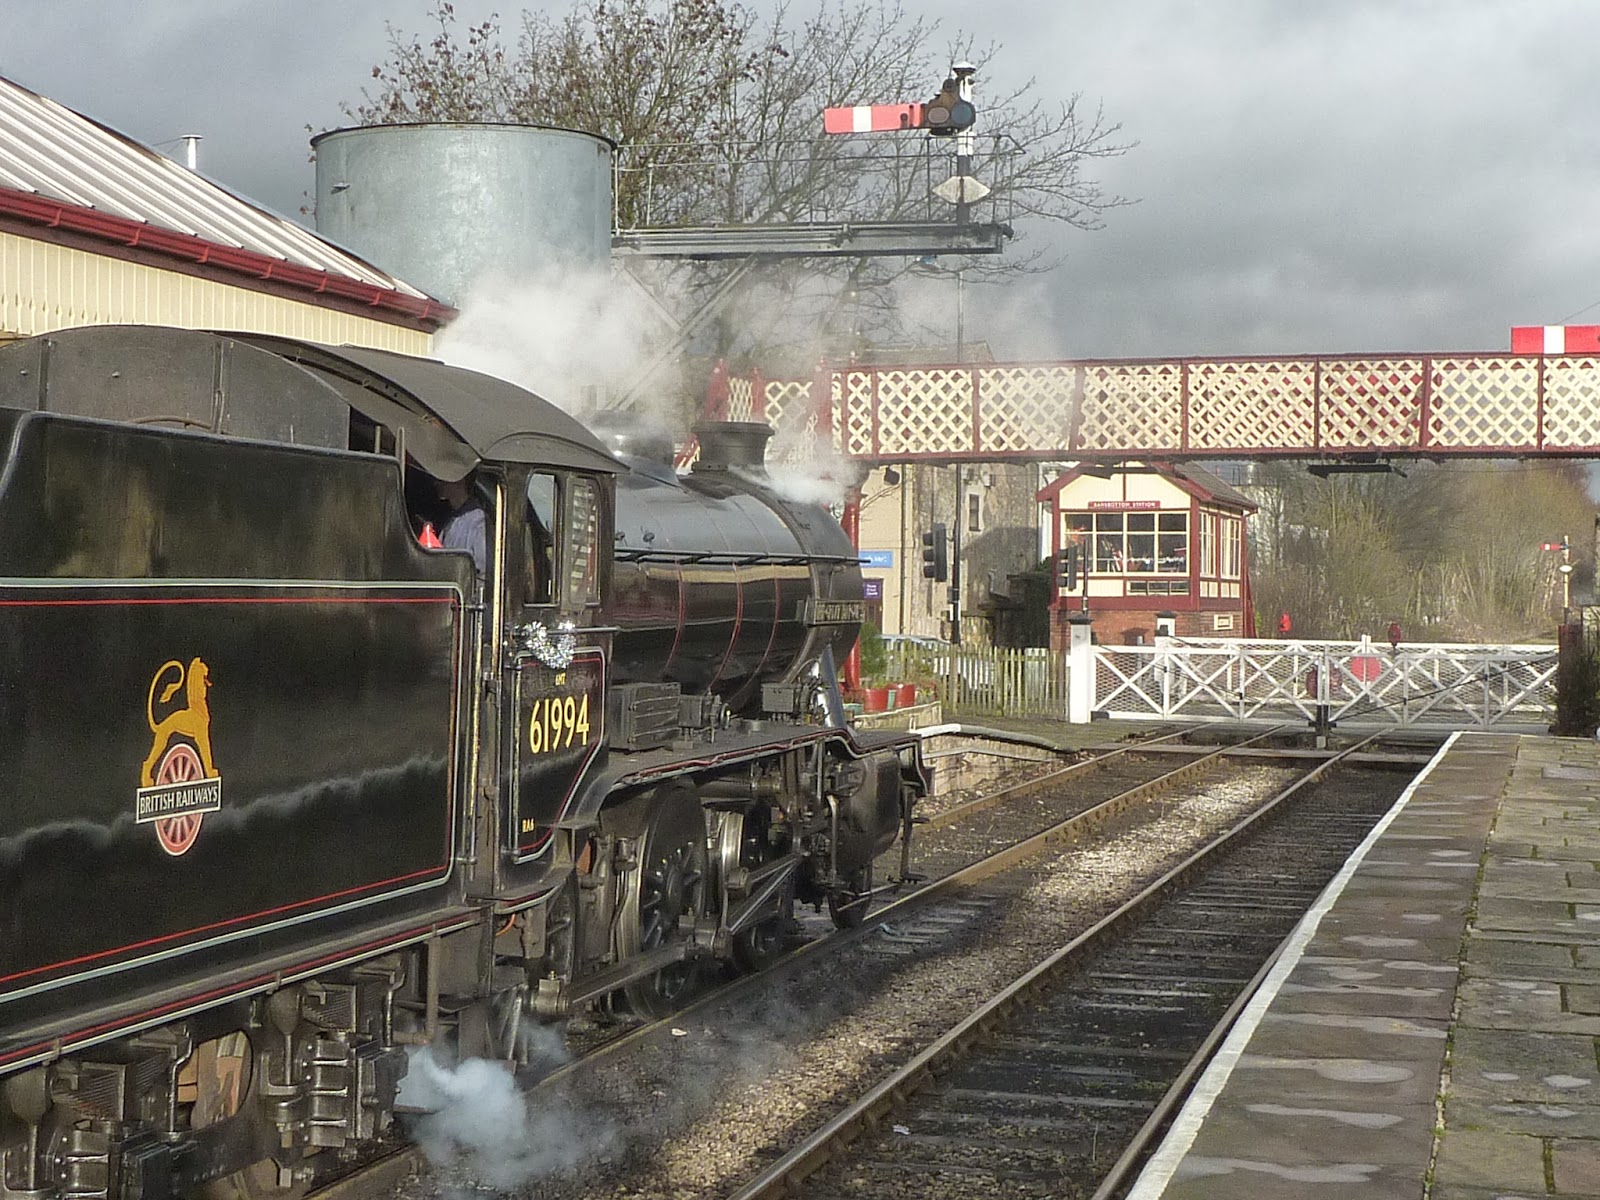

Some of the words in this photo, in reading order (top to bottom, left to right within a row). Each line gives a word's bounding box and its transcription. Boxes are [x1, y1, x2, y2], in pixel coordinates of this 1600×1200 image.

[530, 693, 590, 754] 61994
[140, 792, 175, 814] BRITISH
[176, 786, 218, 808] RAILWAYS
